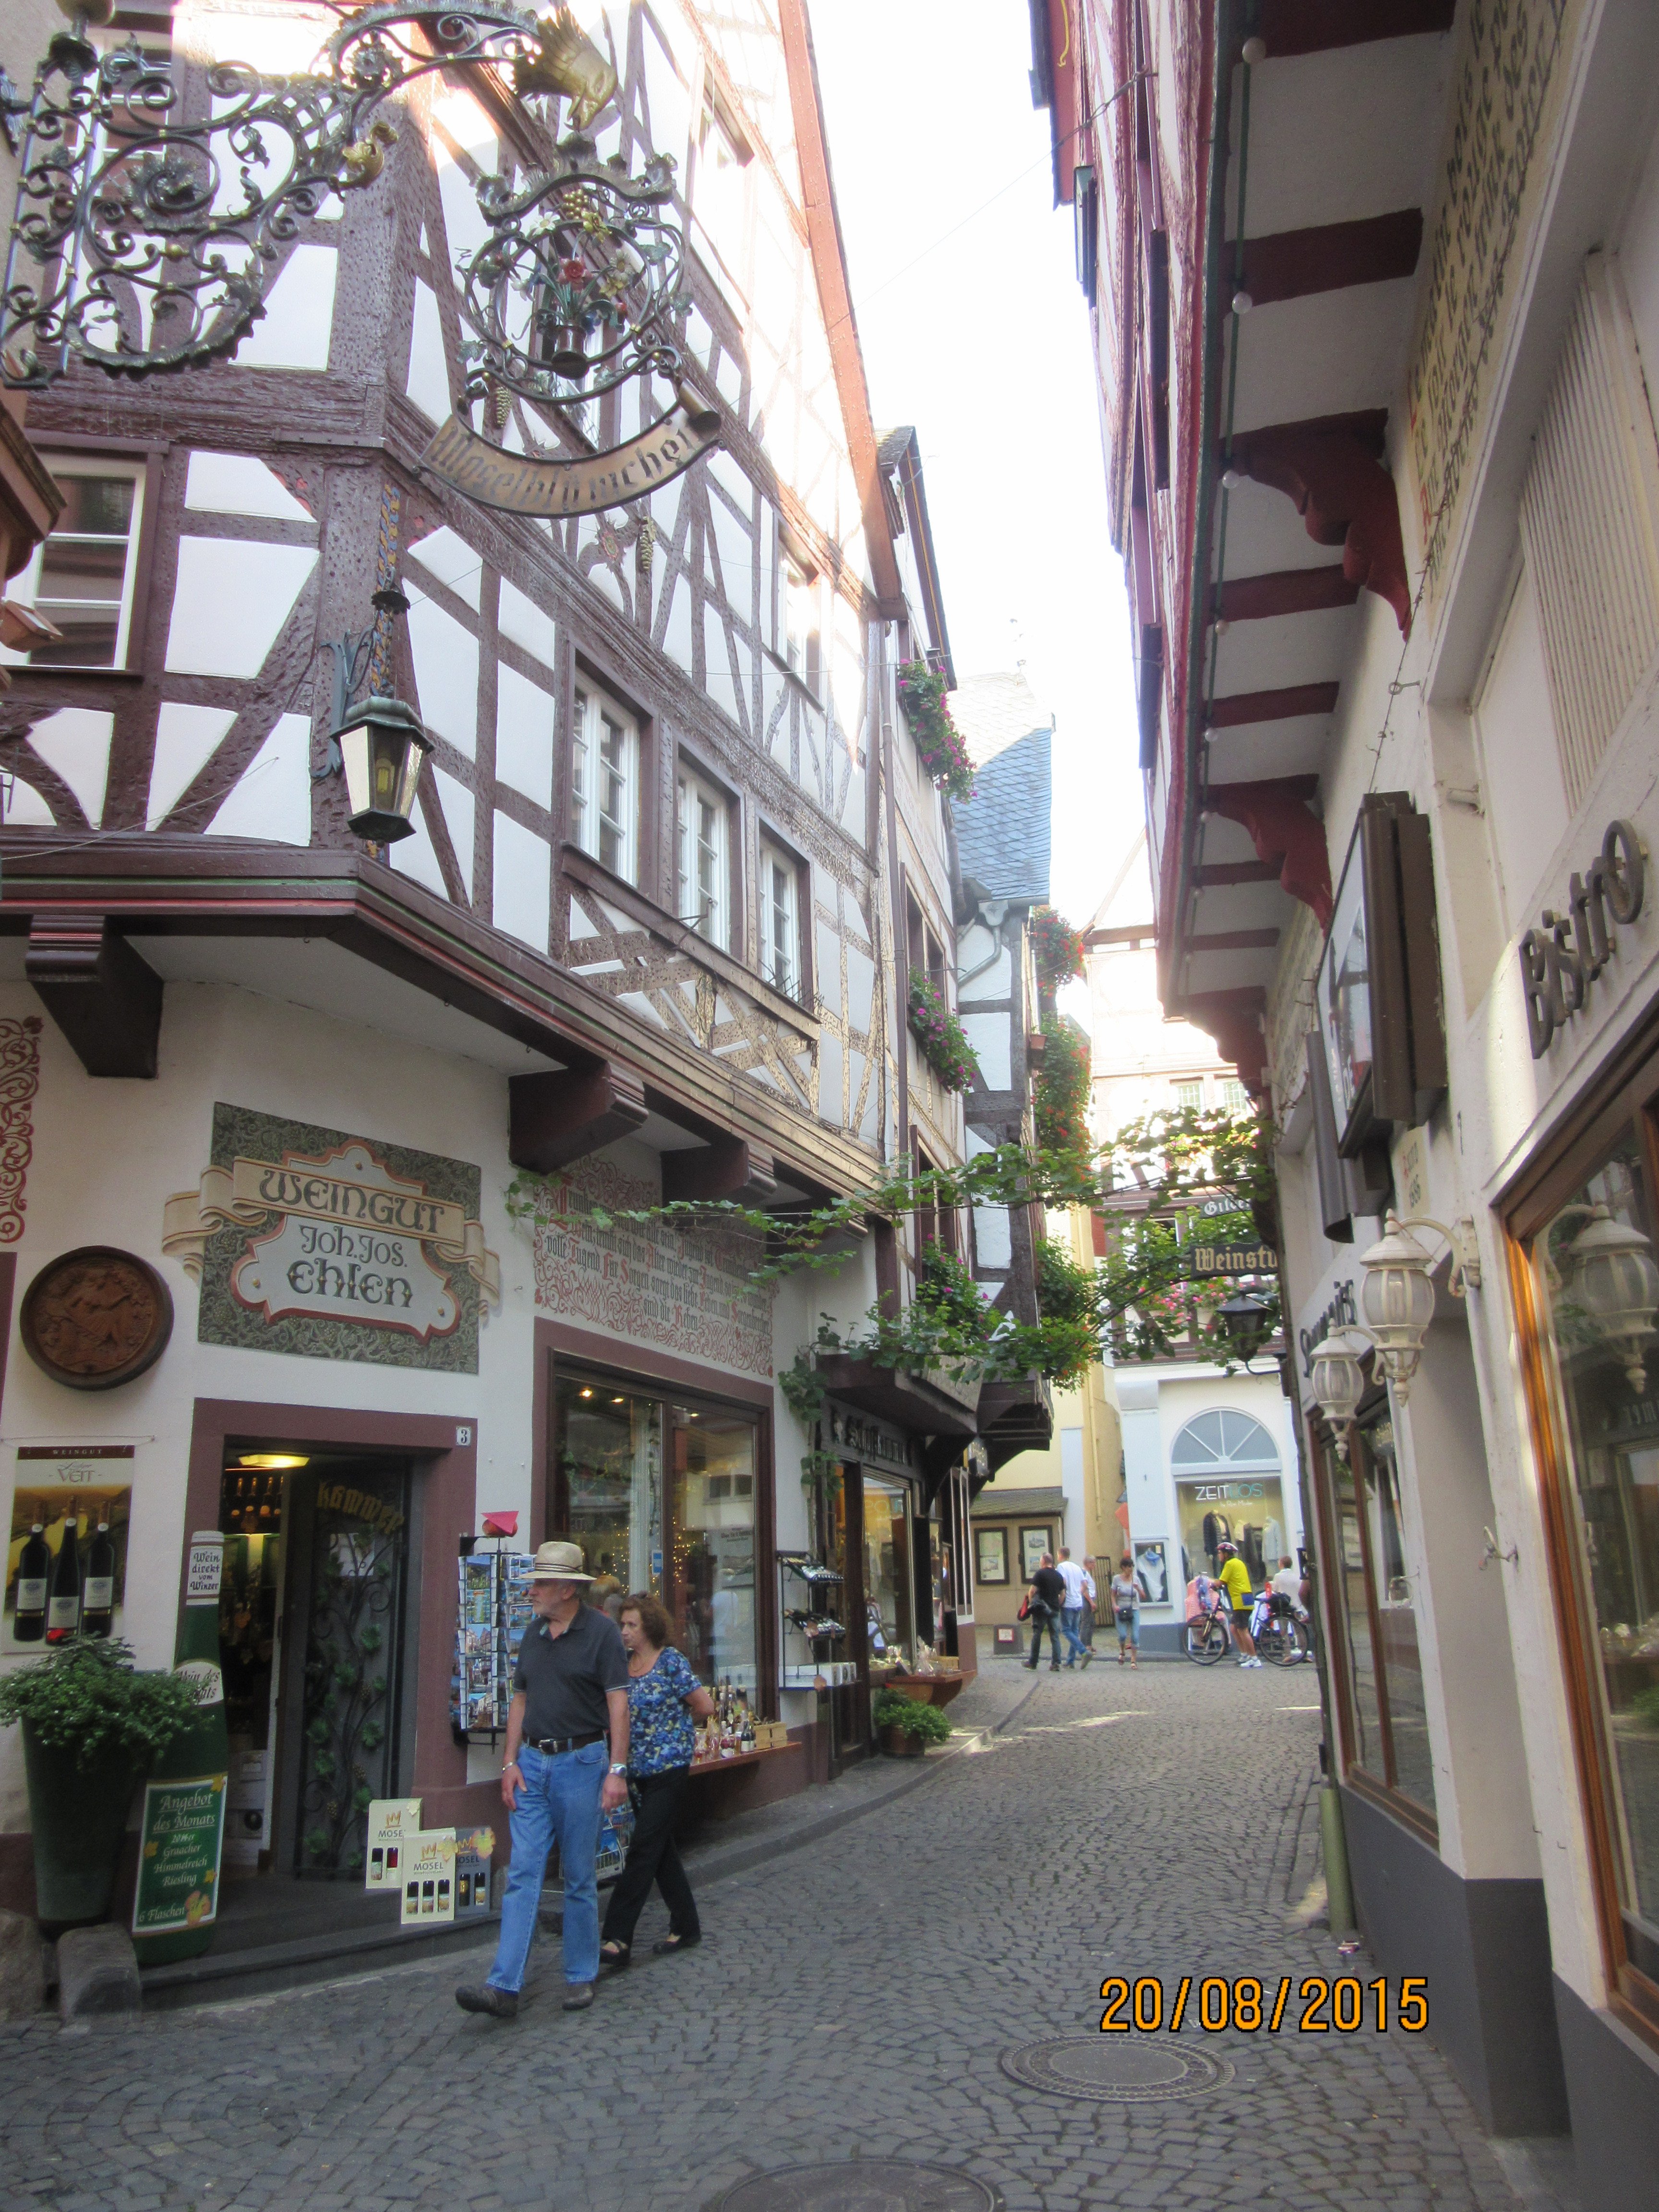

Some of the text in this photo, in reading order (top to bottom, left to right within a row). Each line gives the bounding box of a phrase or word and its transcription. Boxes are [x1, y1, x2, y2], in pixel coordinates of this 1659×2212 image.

[460, 1428, 468, 1443] 3
[193, 1551, 219, 1563] Wein
[192, 1563, 220, 1573] direkt
[159, 1789, 214, 1815] Angebot
[174, 1814, 215, 1828] Monats
[377, 1829, 404, 1838] MOSE
[413, 1863, 444, 1871] MOSEL
[162, 1873, 197, 1887] Riesling
